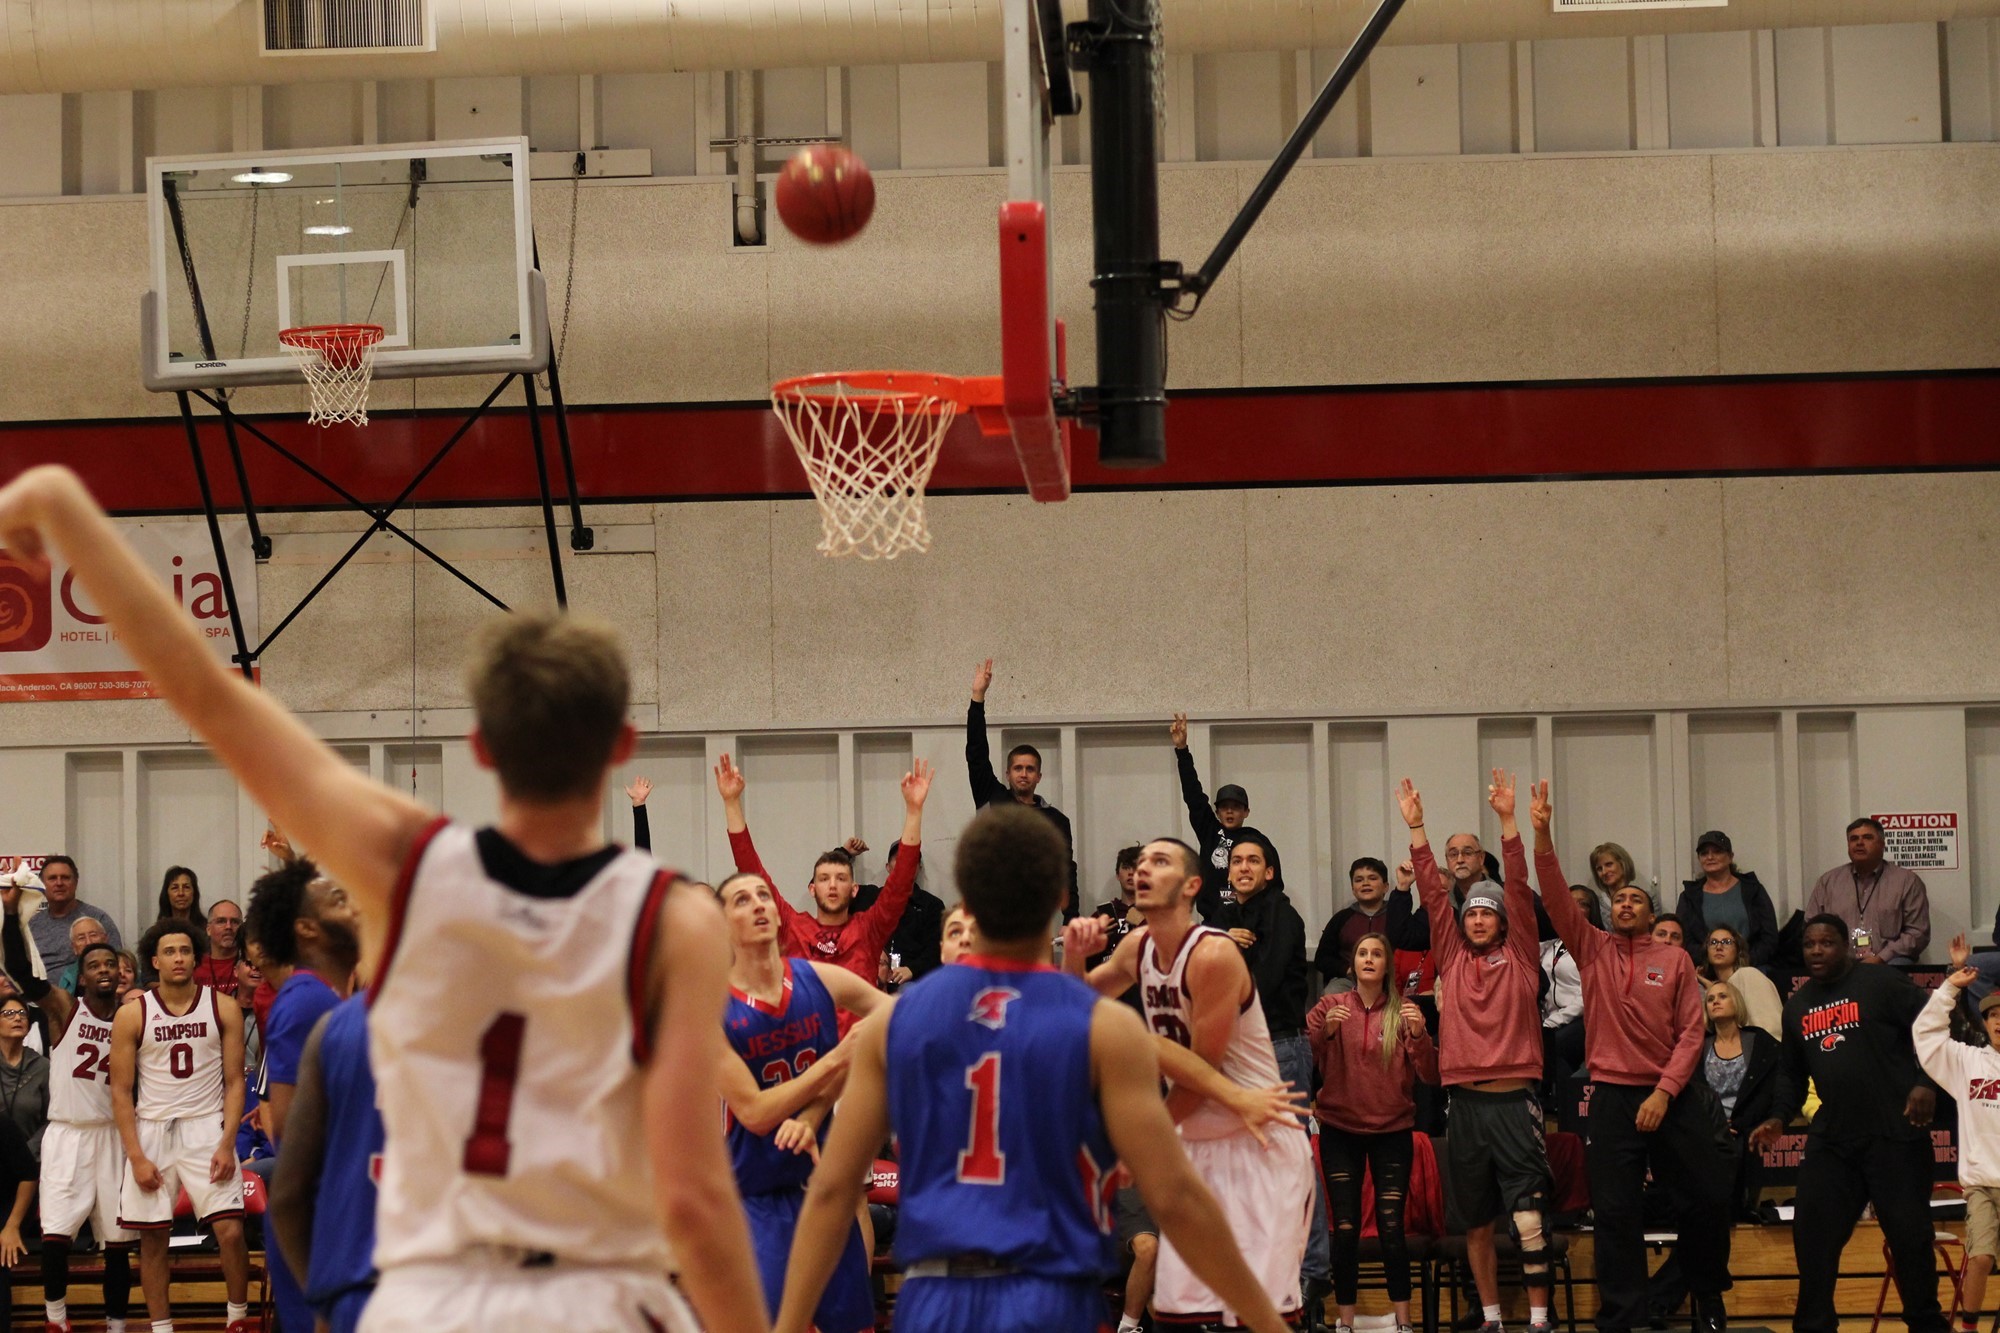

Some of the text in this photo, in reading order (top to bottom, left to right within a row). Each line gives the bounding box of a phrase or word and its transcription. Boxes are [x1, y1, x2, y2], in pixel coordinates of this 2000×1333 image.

[60, 631, 102, 642] HOTEL
[205, 627, 231, 638] SPA
[1878, 816, 1951, 828] CAUTION
[1808, 998, 1849, 1014] RED HAWKS
[1802, 1001, 1859, 1036] SIMPSON
[154, 1022, 207, 1042] SIMPSON
[1804, 1021, 1860, 1041] BASKETBALL
[170, 1043, 194, 1079] 0
[463, 1011, 527, 1177] 1
[957, 1052, 1006, 1185] 1
